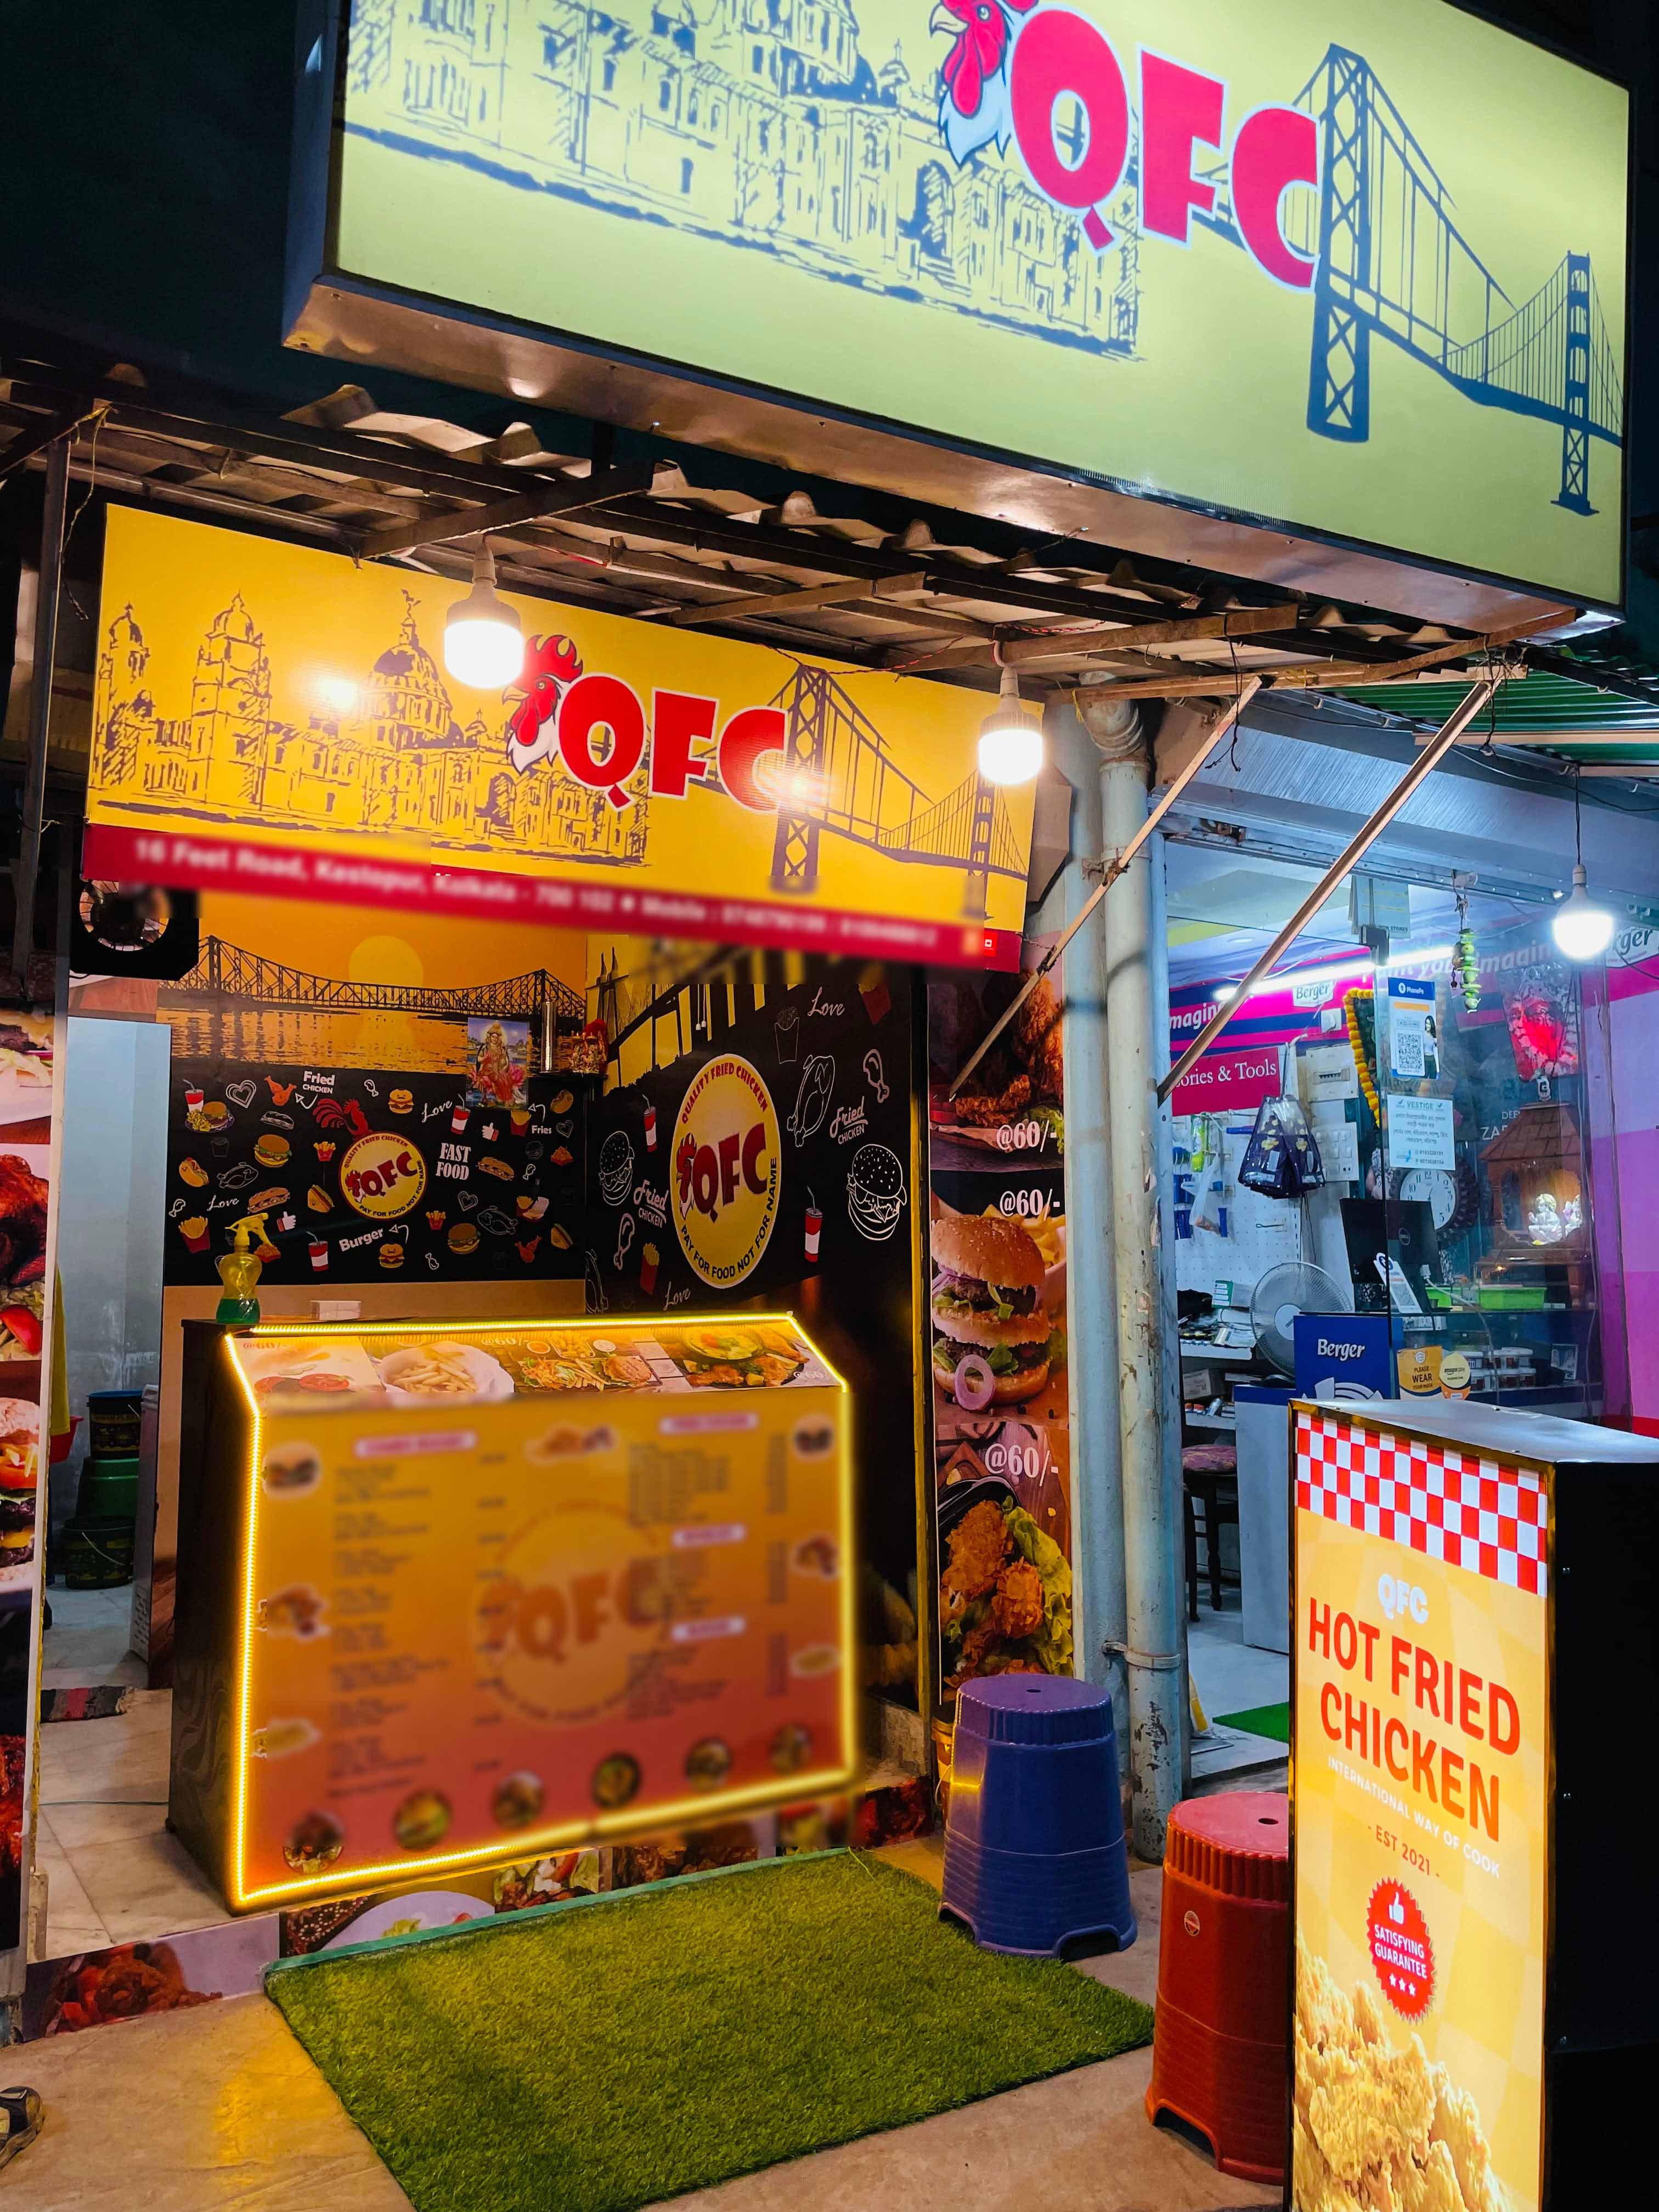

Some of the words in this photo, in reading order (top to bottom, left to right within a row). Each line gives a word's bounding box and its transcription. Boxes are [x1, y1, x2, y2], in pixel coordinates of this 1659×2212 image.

[1009, 7, 1320, 292] QFC
[557, 672, 789, 812] QFC
[808, 987, 845, 1016] Love
[1296, 984, 1330, 1001] Berger
[1170, 1002, 1223, 1030] magin
[303, 1071, 335, 1086] Fried
[1217, 1065, 1232, 1081] &
[1235, 1058, 1276, 1080] Tools
[302, 1084, 334, 1094] CHICKEN
[682, 1071, 709, 1124] QUALITY
[711, 1063, 734, 1080] FRIED
[736, 1066, 768, 1113] CHICKEN
[421, 1100, 453, 1122] Love
[830, 1096, 868, 1138] Fried
[532, 1125, 552, 1135] Fries
[838, 1126, 865, 1145] CHICKEN
[996, 1120, 1057, 1153] @60/-
[440, 1143, 471, 1163] FAST
[360, 1151, 418, 1197] QFC
[436, 1161, 470, 1180] FOOD
[692, 1123, 768, 1223] QFC
[207, 1194, 240, 1211] Love
[359, 1205, 371, 1214] PAY
[388, 1206, 405, 1216] FOOD
[407, 1194, 417, 1207] NOT
[633, 1180, 668, 1212] Fried
[1000, 1189, 1060, 1221] @60/-
[638, 1208, 663, 1228] CHICKEN
[681, 1224, 694, 1251] PAY
[693, 1250, 710, 1274] FOR
[712, 1265, 735, 1279] FOOD
[737, 1246, 755, 1273] NOT
[755, 1214, 770, 1249] FOR
[766, 1157, 777, 1211] NAME
[338, 1227, 384, 1251] Burger
[664, 1281, 691, 1311] Love
[1317, 1339, 1365, 1361] Berger
[1412, 1373, 1432, 1383] WEAR
[985, 1443, 1058, 1486] @60/-
[1378, 1573, 1429, 1624] QFC
[1310, 1596, 1380, 1682] HOT
[1392, 1634, 1520, 1755] FRIED
[1321, 1682, 1499, 1842] CHICKEN
[1328, 1755, 1410, 1820] INTERNATIONAL
[1414, 1809, 1440, 1837] WAY
[1443, 1830, 1460, 1850] OF
[1463, 1843, 1501, 1878] COOK
[1376, 1825, 1398, 1852] EST
[1402, 1843, 1430, 1876] 2021
[1374, 1924, 1424, 1959] SATISFYING
[1374, 1943, 1427, 1979] GUARANTEE
